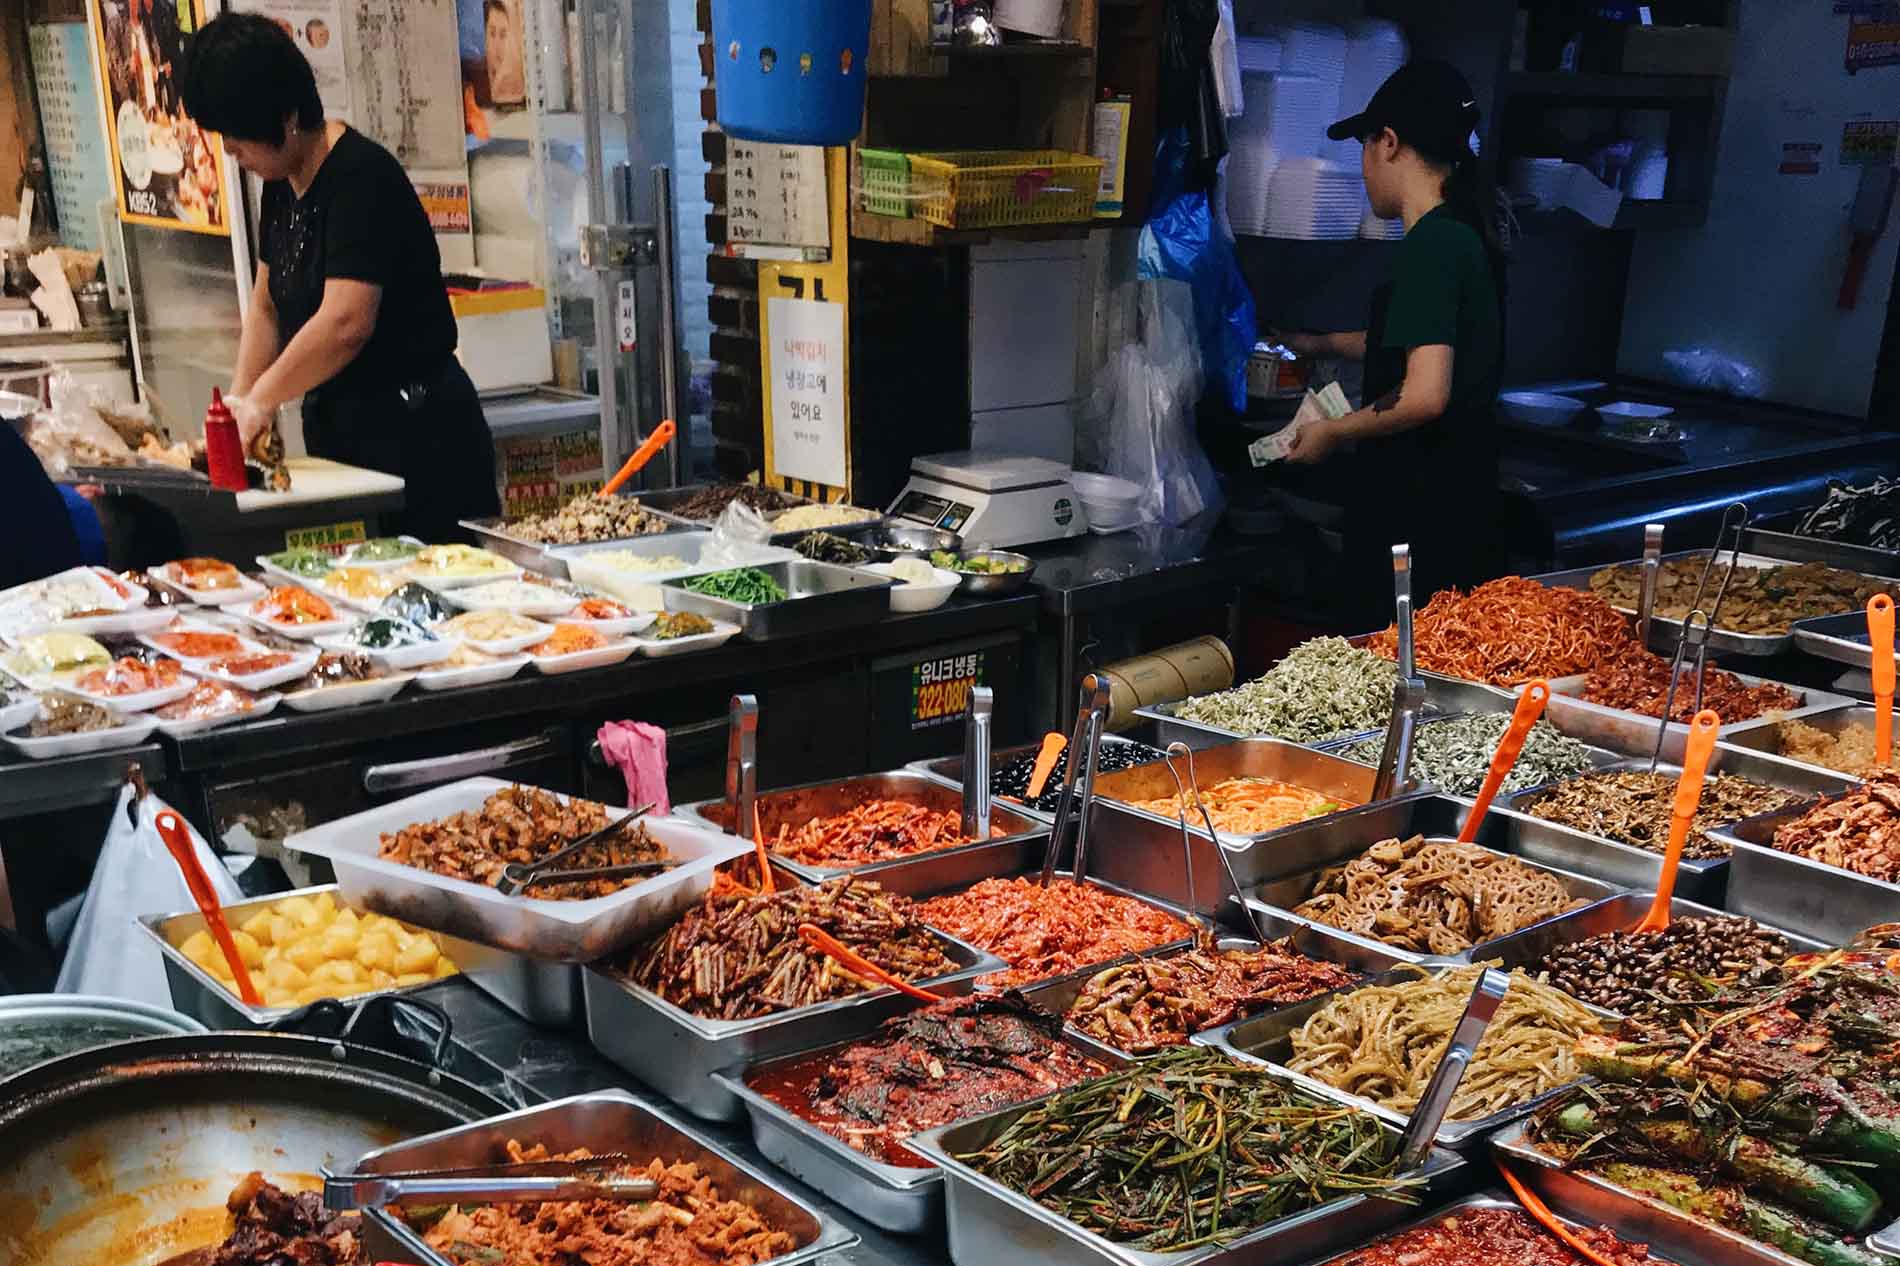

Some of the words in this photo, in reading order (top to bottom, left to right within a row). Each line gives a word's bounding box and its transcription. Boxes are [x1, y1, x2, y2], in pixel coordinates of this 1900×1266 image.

[128, 191, 158, 215] KBS2
[785, 370, 827, 393] 냉장고에
[790, 400, 823, 422] 있어요
[920, 654, 977, 685] 유니크냉동
[918, 676, 975, 720] 322-080
